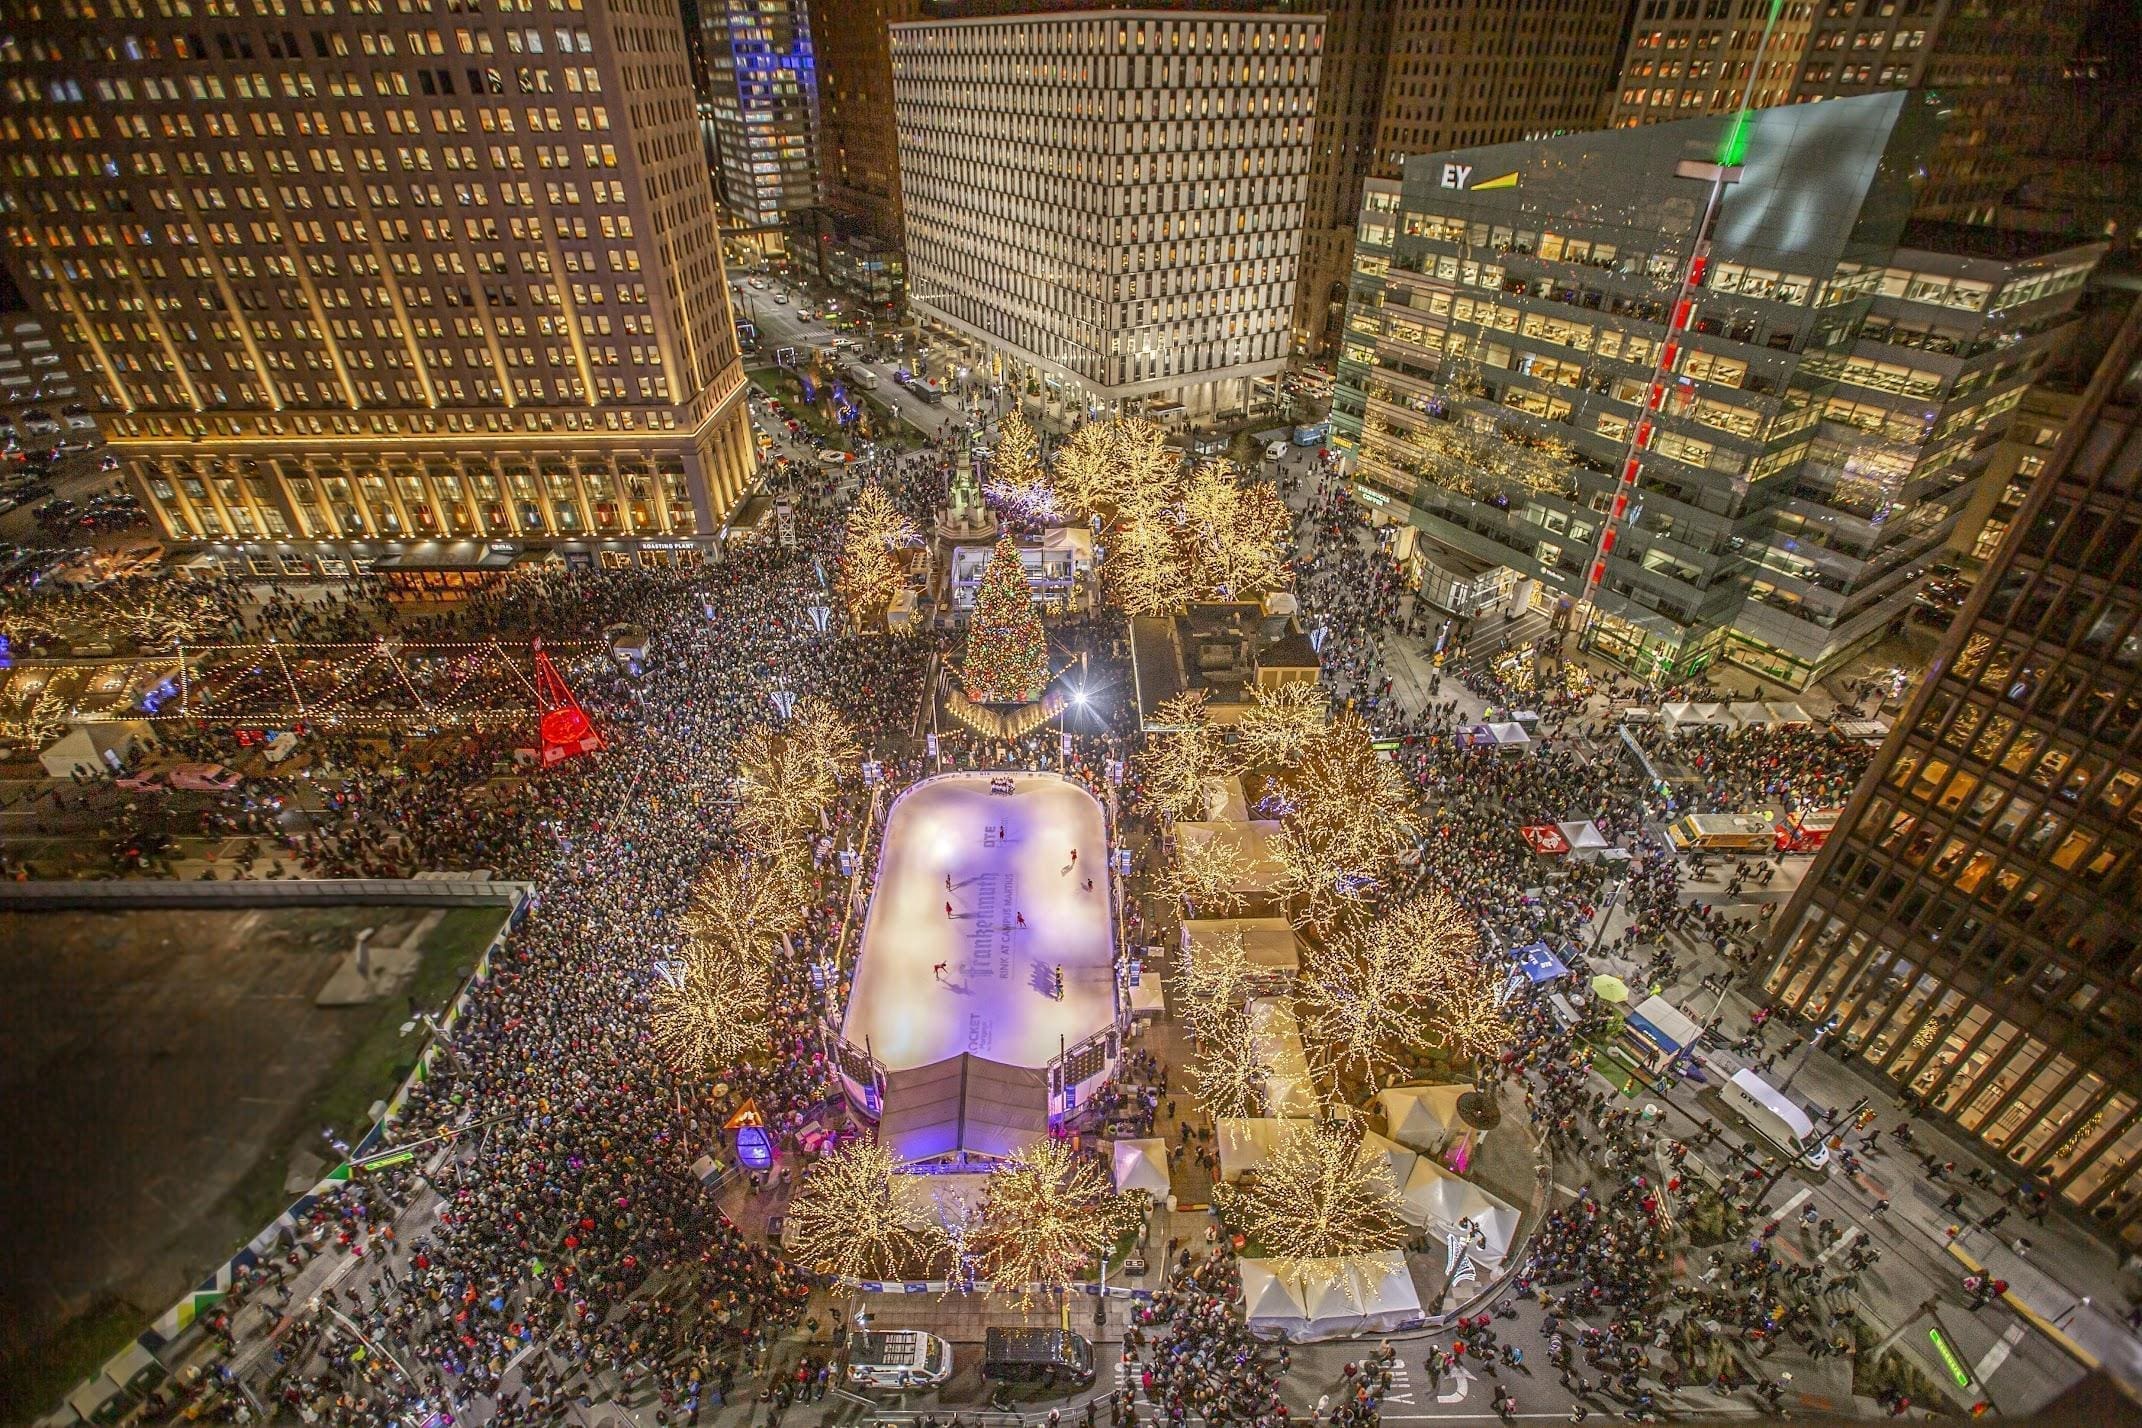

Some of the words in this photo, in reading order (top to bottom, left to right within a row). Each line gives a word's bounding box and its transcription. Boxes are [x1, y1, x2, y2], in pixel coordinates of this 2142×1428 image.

[1440, 163, 1473, 190] EY
[1358, 485, 1390, 503] STARBUCKS
[983, 826, 996, 848] DTE
[1004, 873, 1015, 904] MARTIUS
[1001, 907, 1012, 942] CAMPUS
[1000, 944, 1010, 955] AT
[1000, 958, 1009, 979] RINK
[1683, 1005, 1697, 1020] DTE
[969, 1013, 981, 1054] OCKET
[1740, 1091, 1760, 1108] DTE
